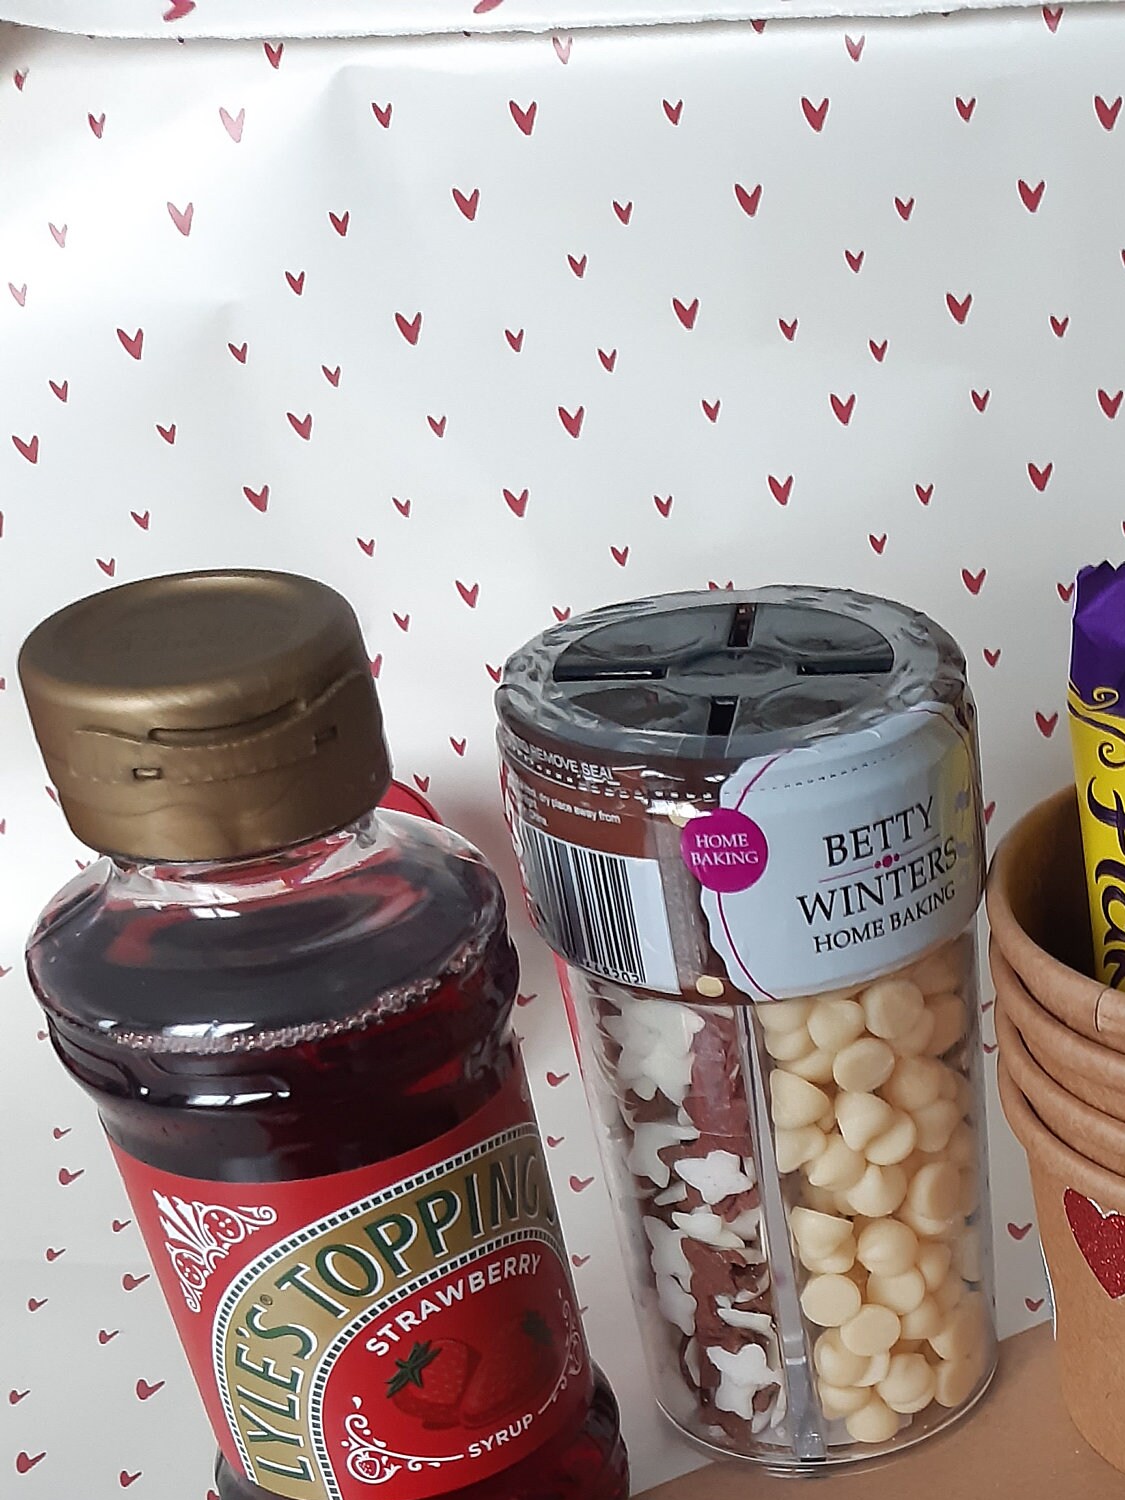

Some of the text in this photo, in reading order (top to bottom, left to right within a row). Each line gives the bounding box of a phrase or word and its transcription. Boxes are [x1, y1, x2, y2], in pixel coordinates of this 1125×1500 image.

[599, 810, 622, 824] from
[695, 833, 749, 848] HOME
[822, 795, 933, 868] BETTY
[690, 851, 759, 866] BAKING
[796, 836, 957, 926] WINTERS
[813, 881, 956, 953] HOME BAKING
[235, 1149, 540, 1482] LYLE'S TOPPING
[366, 1255, 542, 1357] STRAWBERRY
[468, 1414, 534, 1459] SYRUP
